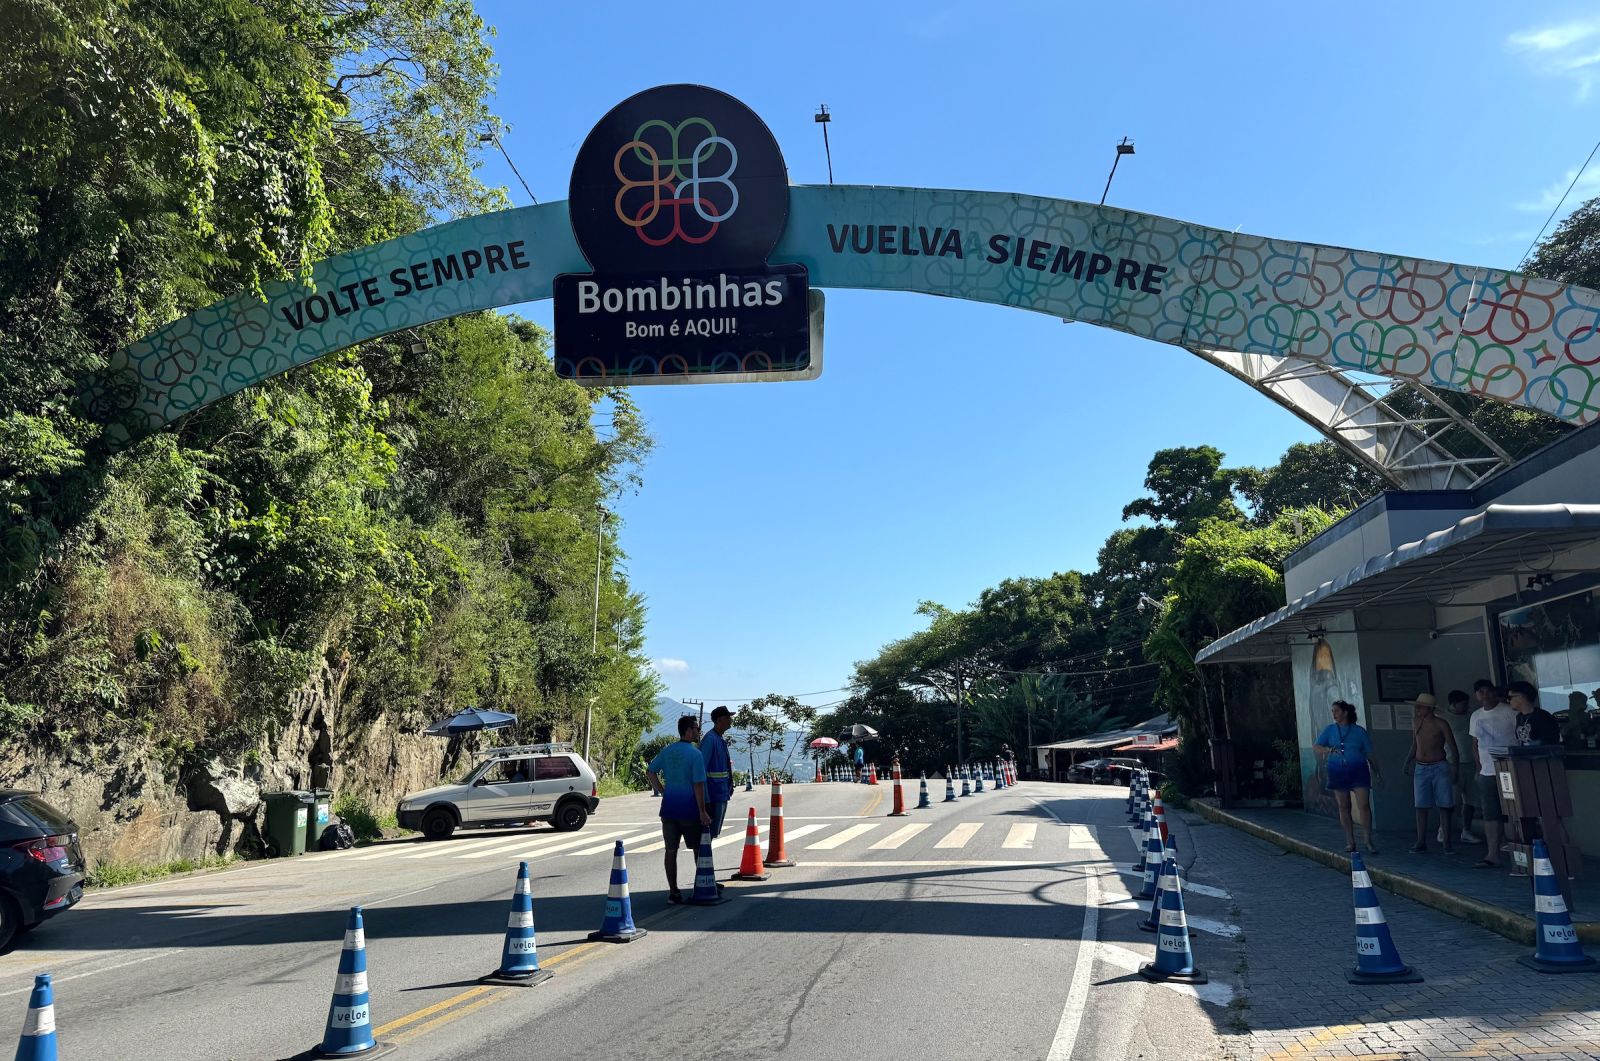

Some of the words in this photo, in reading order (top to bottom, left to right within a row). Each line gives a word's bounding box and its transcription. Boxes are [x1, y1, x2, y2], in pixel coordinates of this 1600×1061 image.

[826, 223, 964, 260] VUELVA
[985, 234, 1168, 295] SIEMPRE
[281, 277, 385, 331] VOLTE
[389, 240, 530, 297] SEMPRE
[578, 273, 783, 314] Bombinhas
[625, 321, 665, 338] Bom
[669, 319, 680, 337] é
[684, 317, 737, 337] AQUI!
[337, 1009, 367, 1024] veloe
